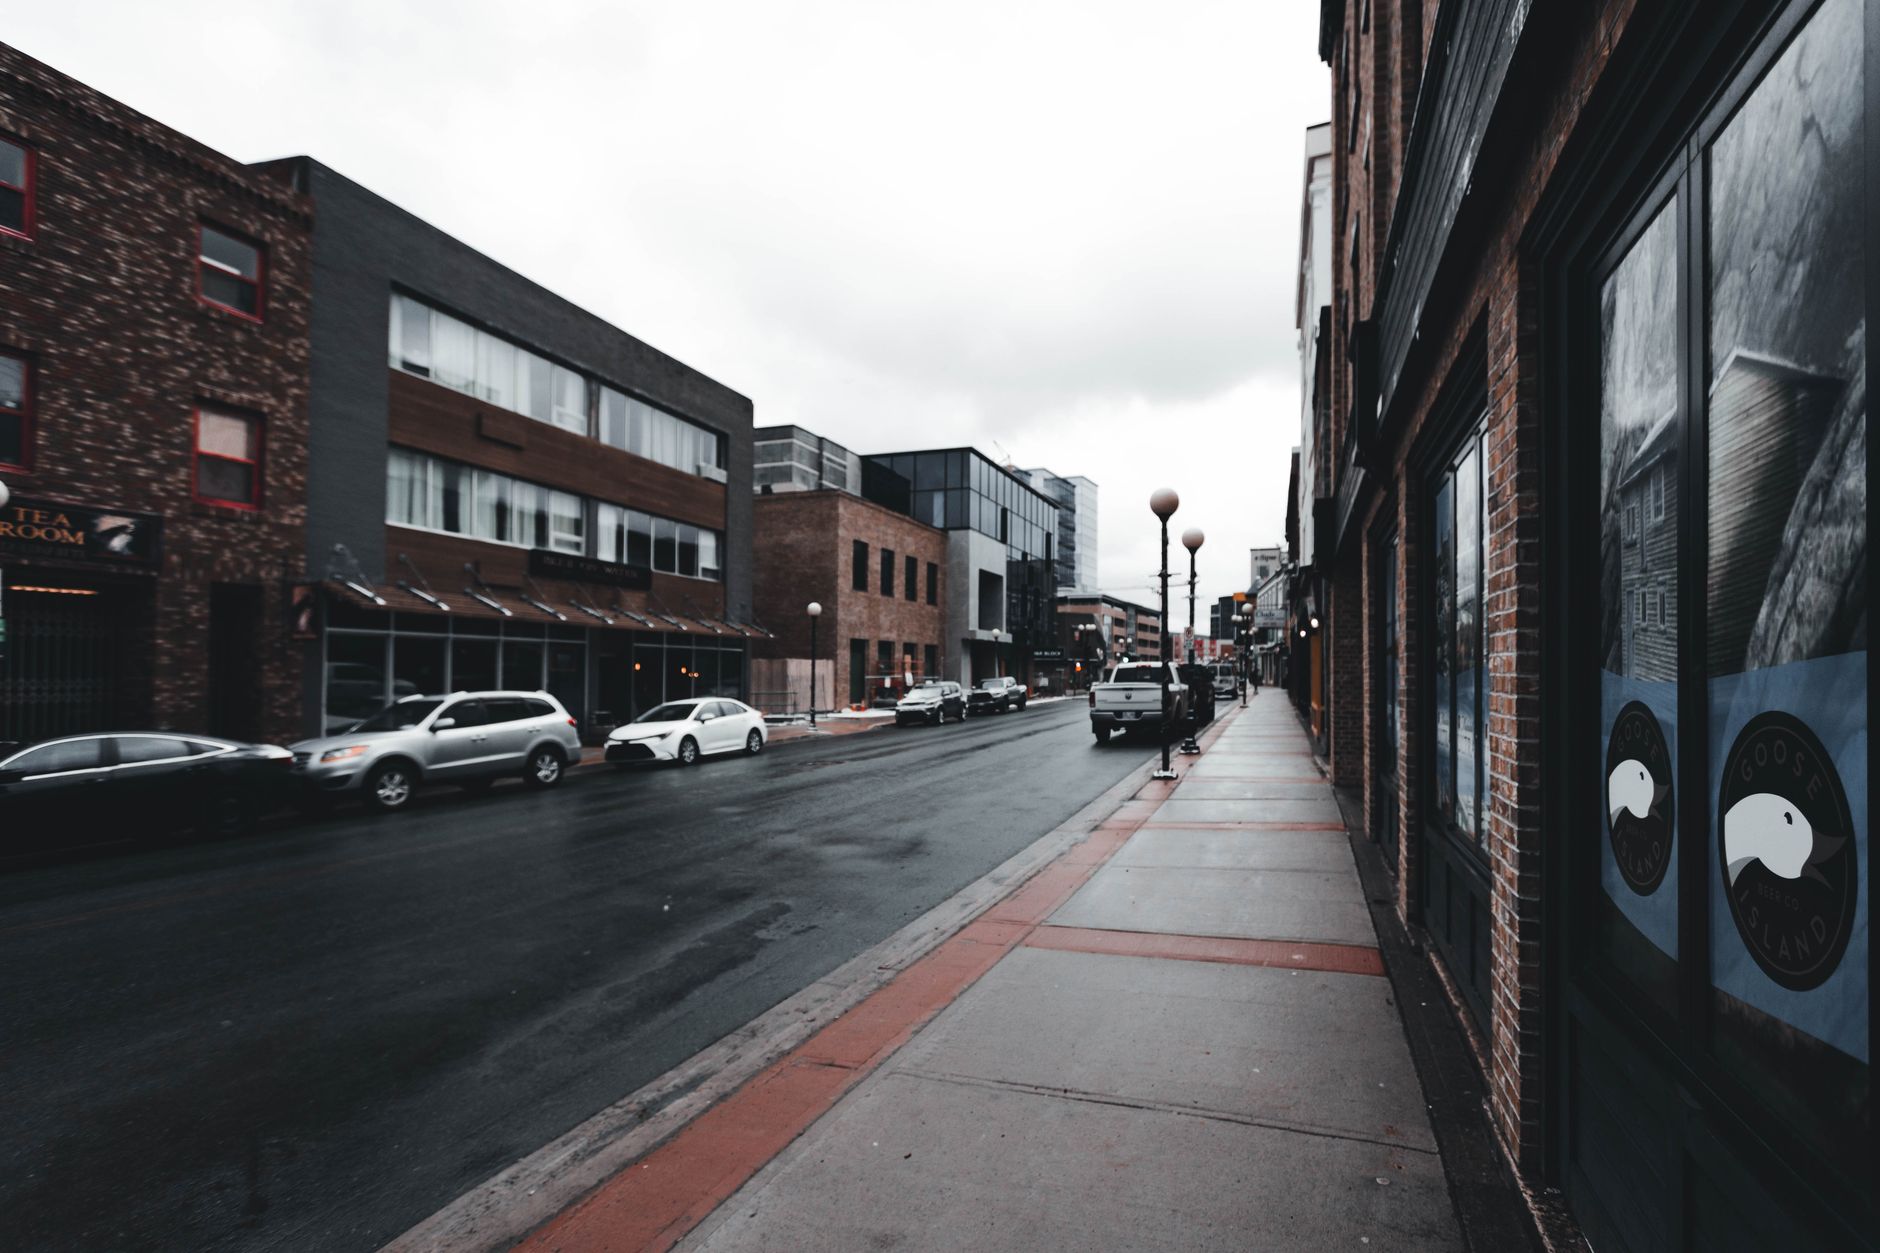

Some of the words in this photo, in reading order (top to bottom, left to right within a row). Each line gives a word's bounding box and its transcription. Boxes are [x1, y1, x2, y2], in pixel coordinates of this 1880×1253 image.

[0, 521, 85, 545] ROOM
[13, 507, 71, 528] TEA
[1618, 722, 1658, 762] GOOSE
[1740, 739, 1822, 800] GOOSE
[1616, 830, 1660, 875] ISLAND
[1757, 882, 1781, 903] BEER
[1740, 888, 1826, 961] ISLAND
